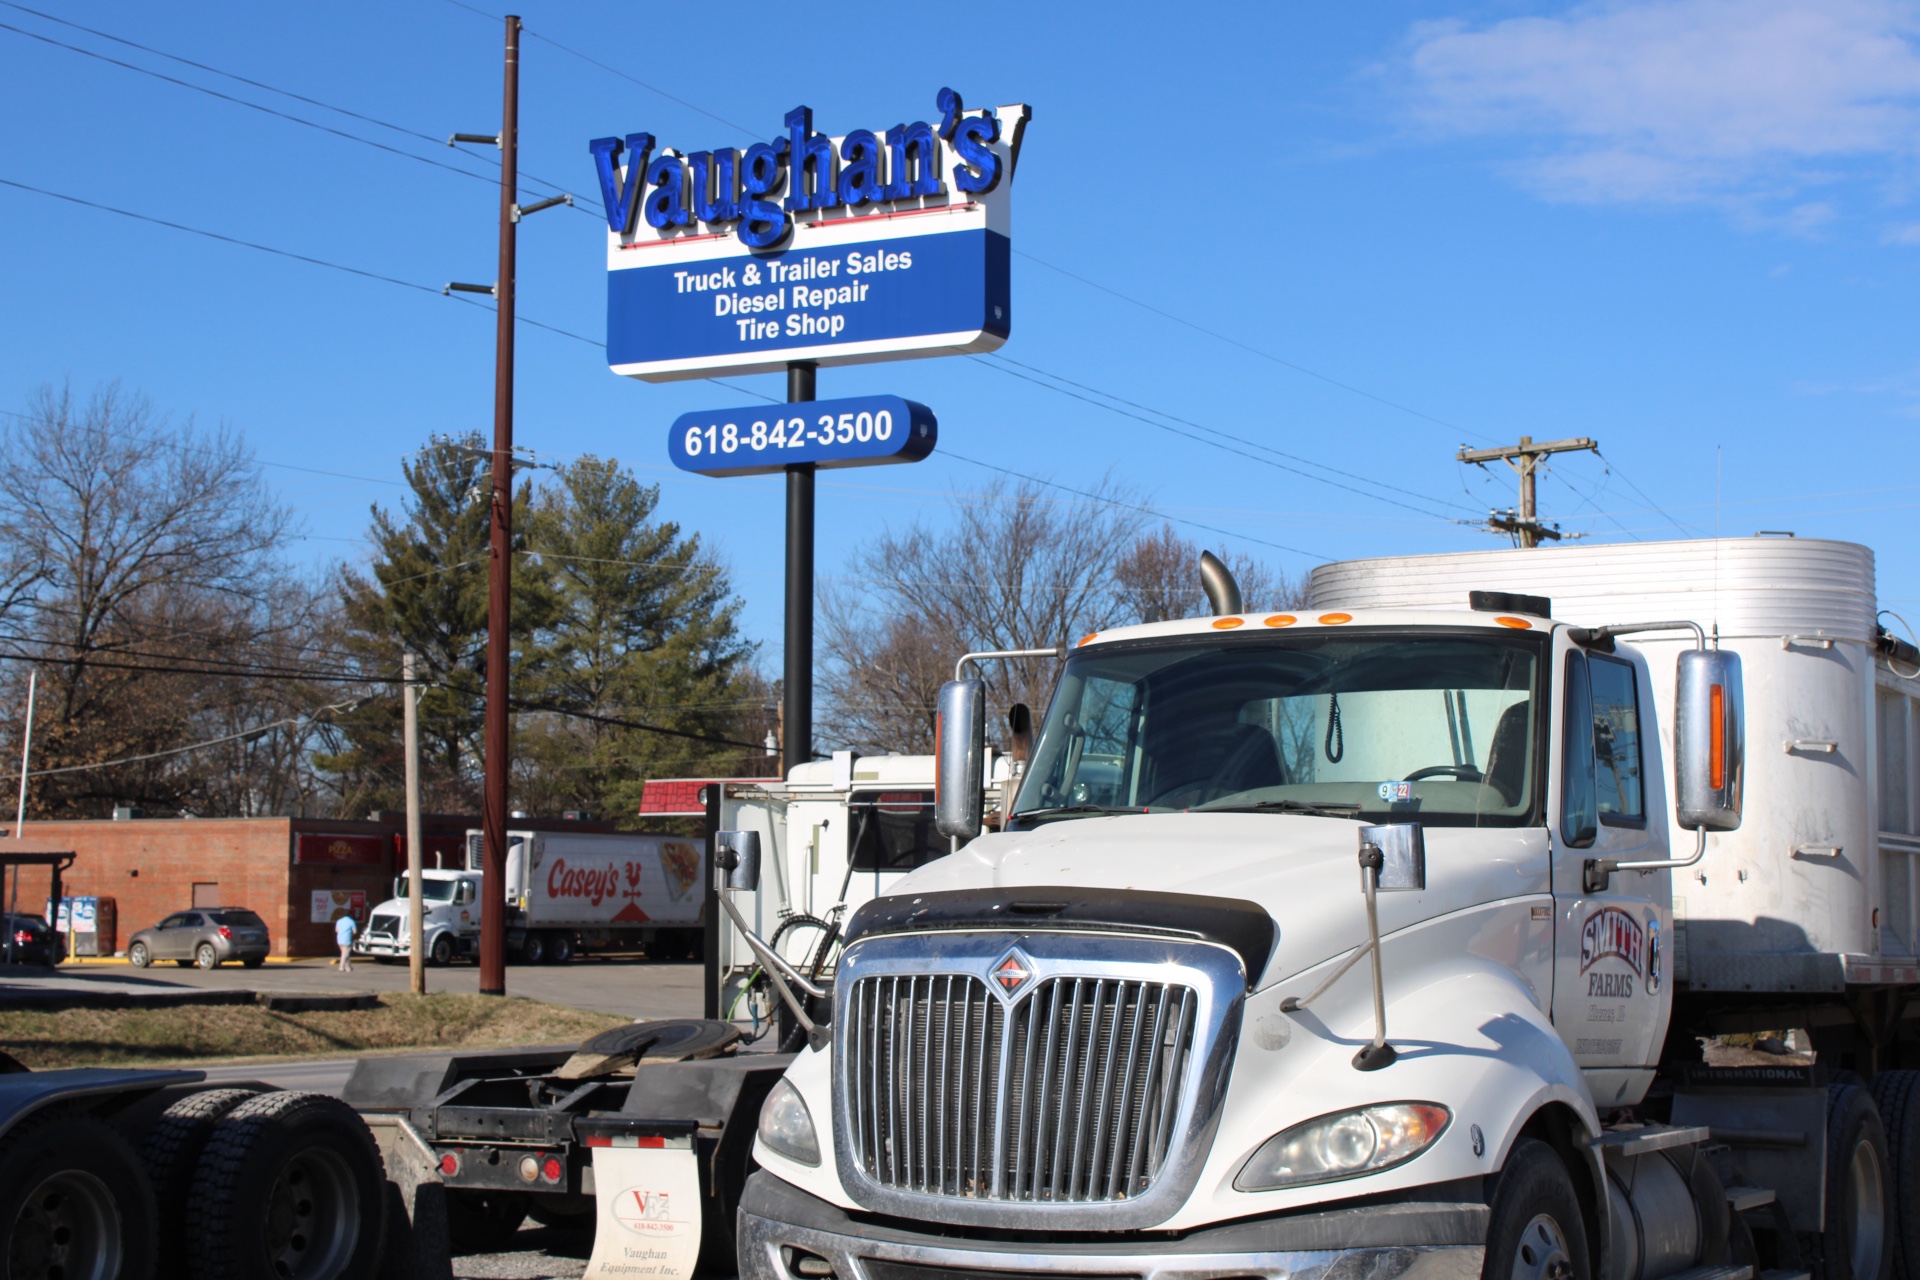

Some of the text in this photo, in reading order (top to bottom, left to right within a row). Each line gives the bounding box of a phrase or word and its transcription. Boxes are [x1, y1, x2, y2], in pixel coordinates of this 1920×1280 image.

[589, 86, 1001, 249] Vaughan's
[674, 249, 913, 294] Truck & Trailer Sales
[715, 280, 870, 317] Diesel Repair
[736, 312, 845, 341] Tire Shop
[684, 409, 893, 457] 618-842-3500
[1398, 784, 1407, 796] 22
[328, 845, 353, 855] PIZZA
[547, 857, 619, 907] Casey's
[1581, 909, 1643, 973] SMITH
[1587, 972, 1634, 998] FARMS
[1691, 1069, 1804, 1080] INTERNATIONAL
[624, 1246, 668, 1260] Vaughan
[600, 1261, 680, 1276] Equipment Inc.
